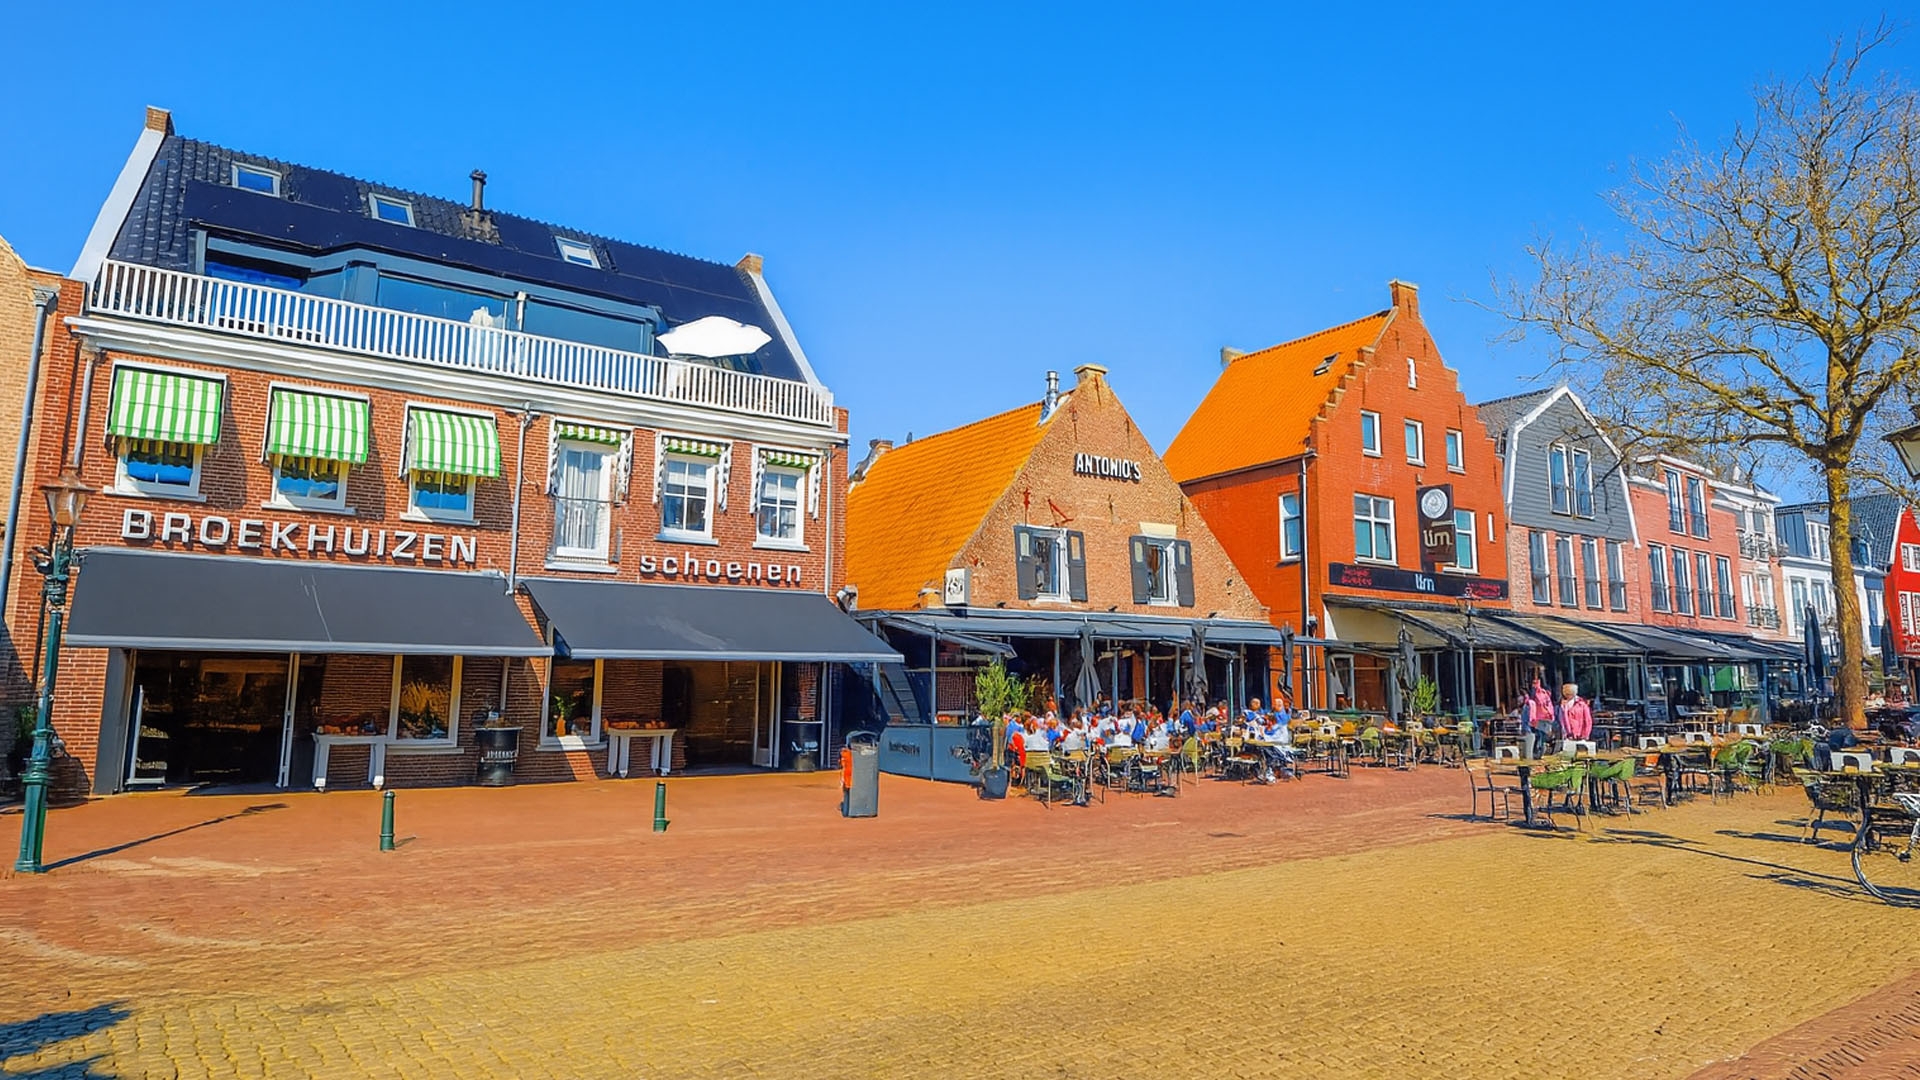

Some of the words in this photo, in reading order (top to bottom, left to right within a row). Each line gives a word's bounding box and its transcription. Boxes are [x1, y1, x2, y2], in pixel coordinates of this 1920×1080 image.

[1075, 452, 1142, 481] ANTONIO'S
[121, 508, 477, 563] BROEKHUIZEN
[640, 551, 801, 583] schoenen
